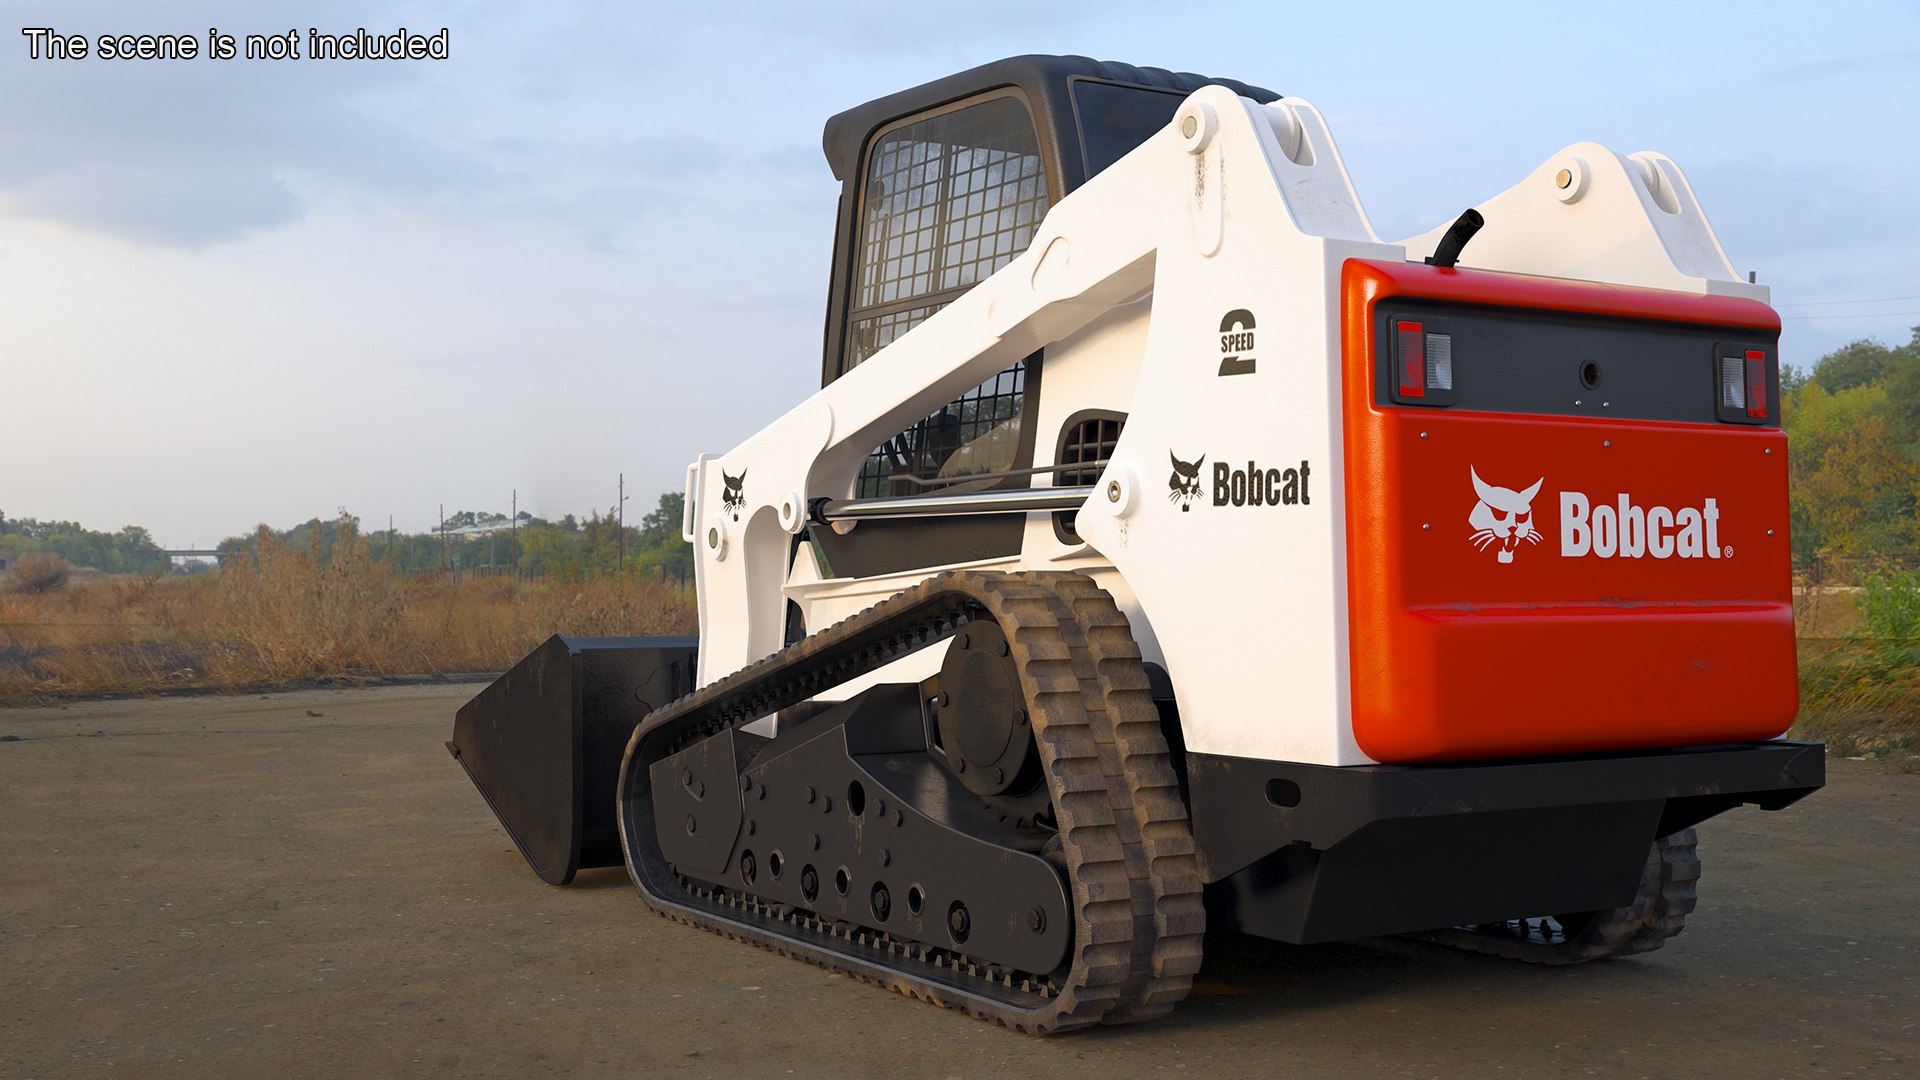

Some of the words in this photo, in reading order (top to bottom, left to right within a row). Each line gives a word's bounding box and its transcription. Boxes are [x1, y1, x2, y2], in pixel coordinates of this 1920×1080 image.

[1220, 332, 1255, 353] SPEED
[1213, 460, 1310, 507] Bobcat
[1560, 491, 1721, 559] Bobcat
